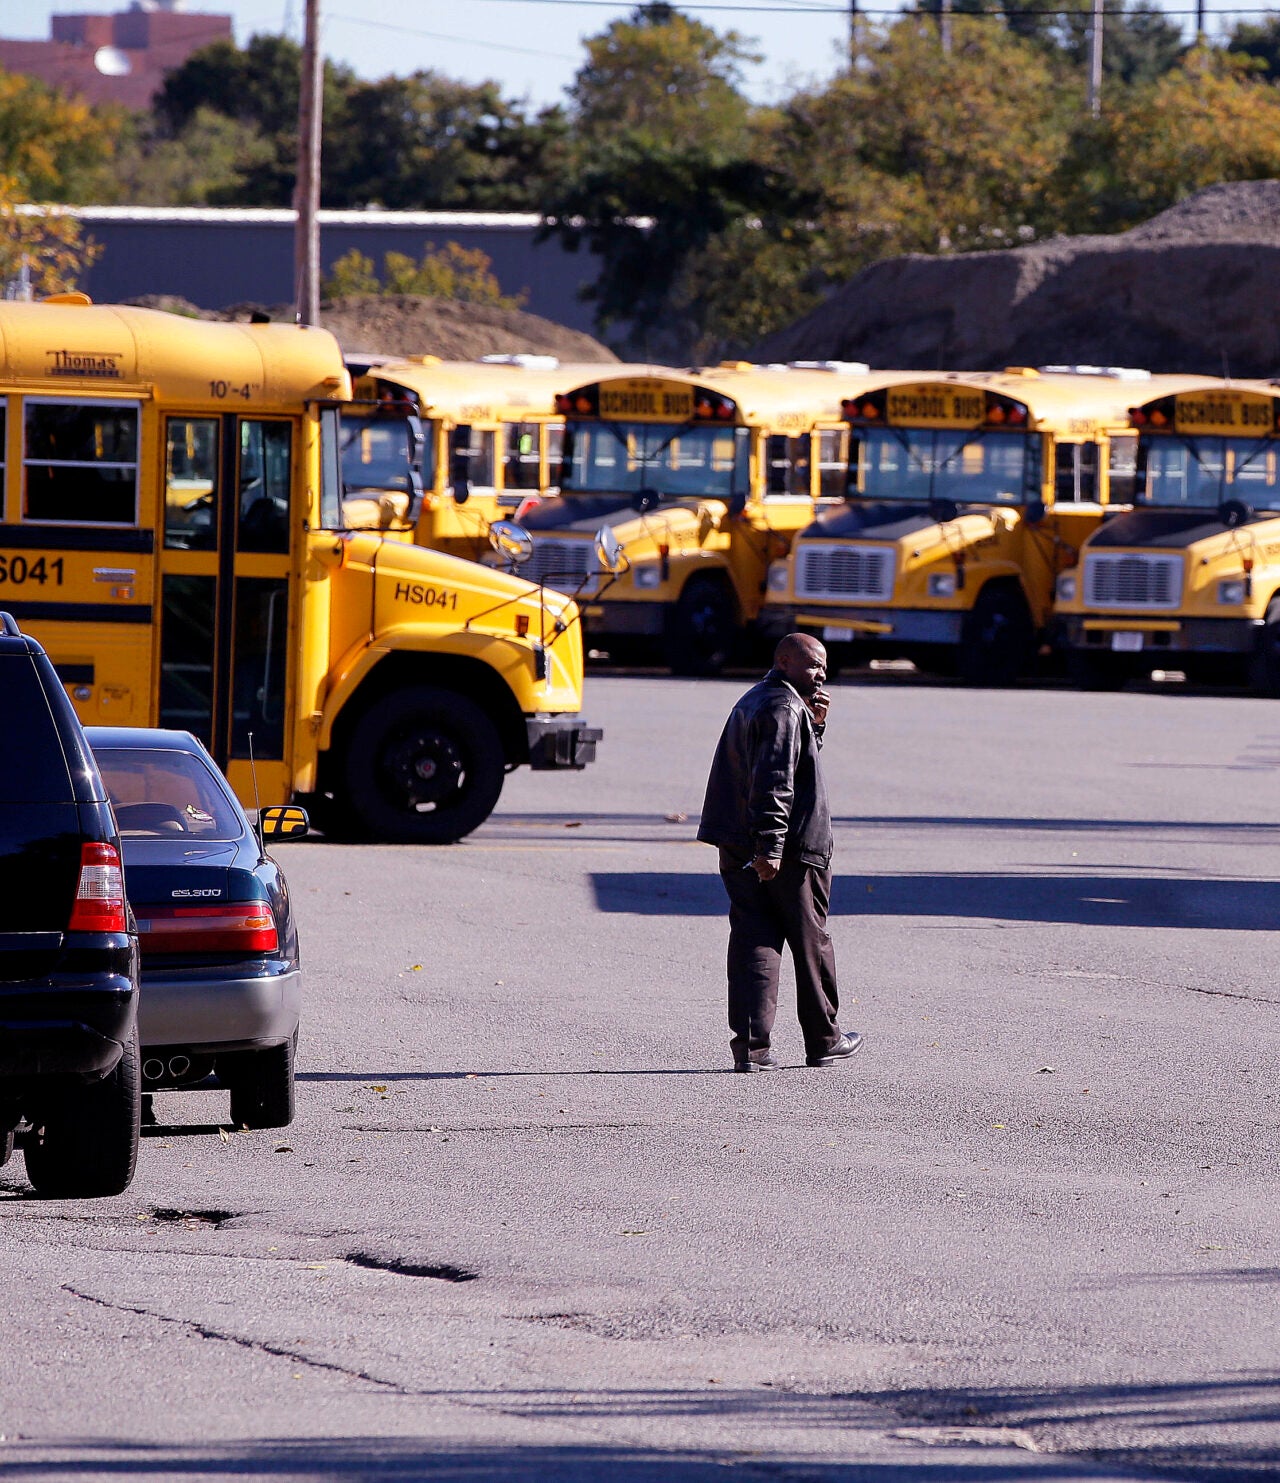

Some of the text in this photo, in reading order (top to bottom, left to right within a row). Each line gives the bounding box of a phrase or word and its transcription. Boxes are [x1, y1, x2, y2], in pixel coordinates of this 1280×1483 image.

[49, 350, 118, 369] Thomas
[601, 391, 690, 415] SCHOOL BUS
[889, 395, 981, 418] SCHOOL BUS
[1177, 400, 1269, 425] SCHOOL BUS
[394, 582, 457, 610] HS041
